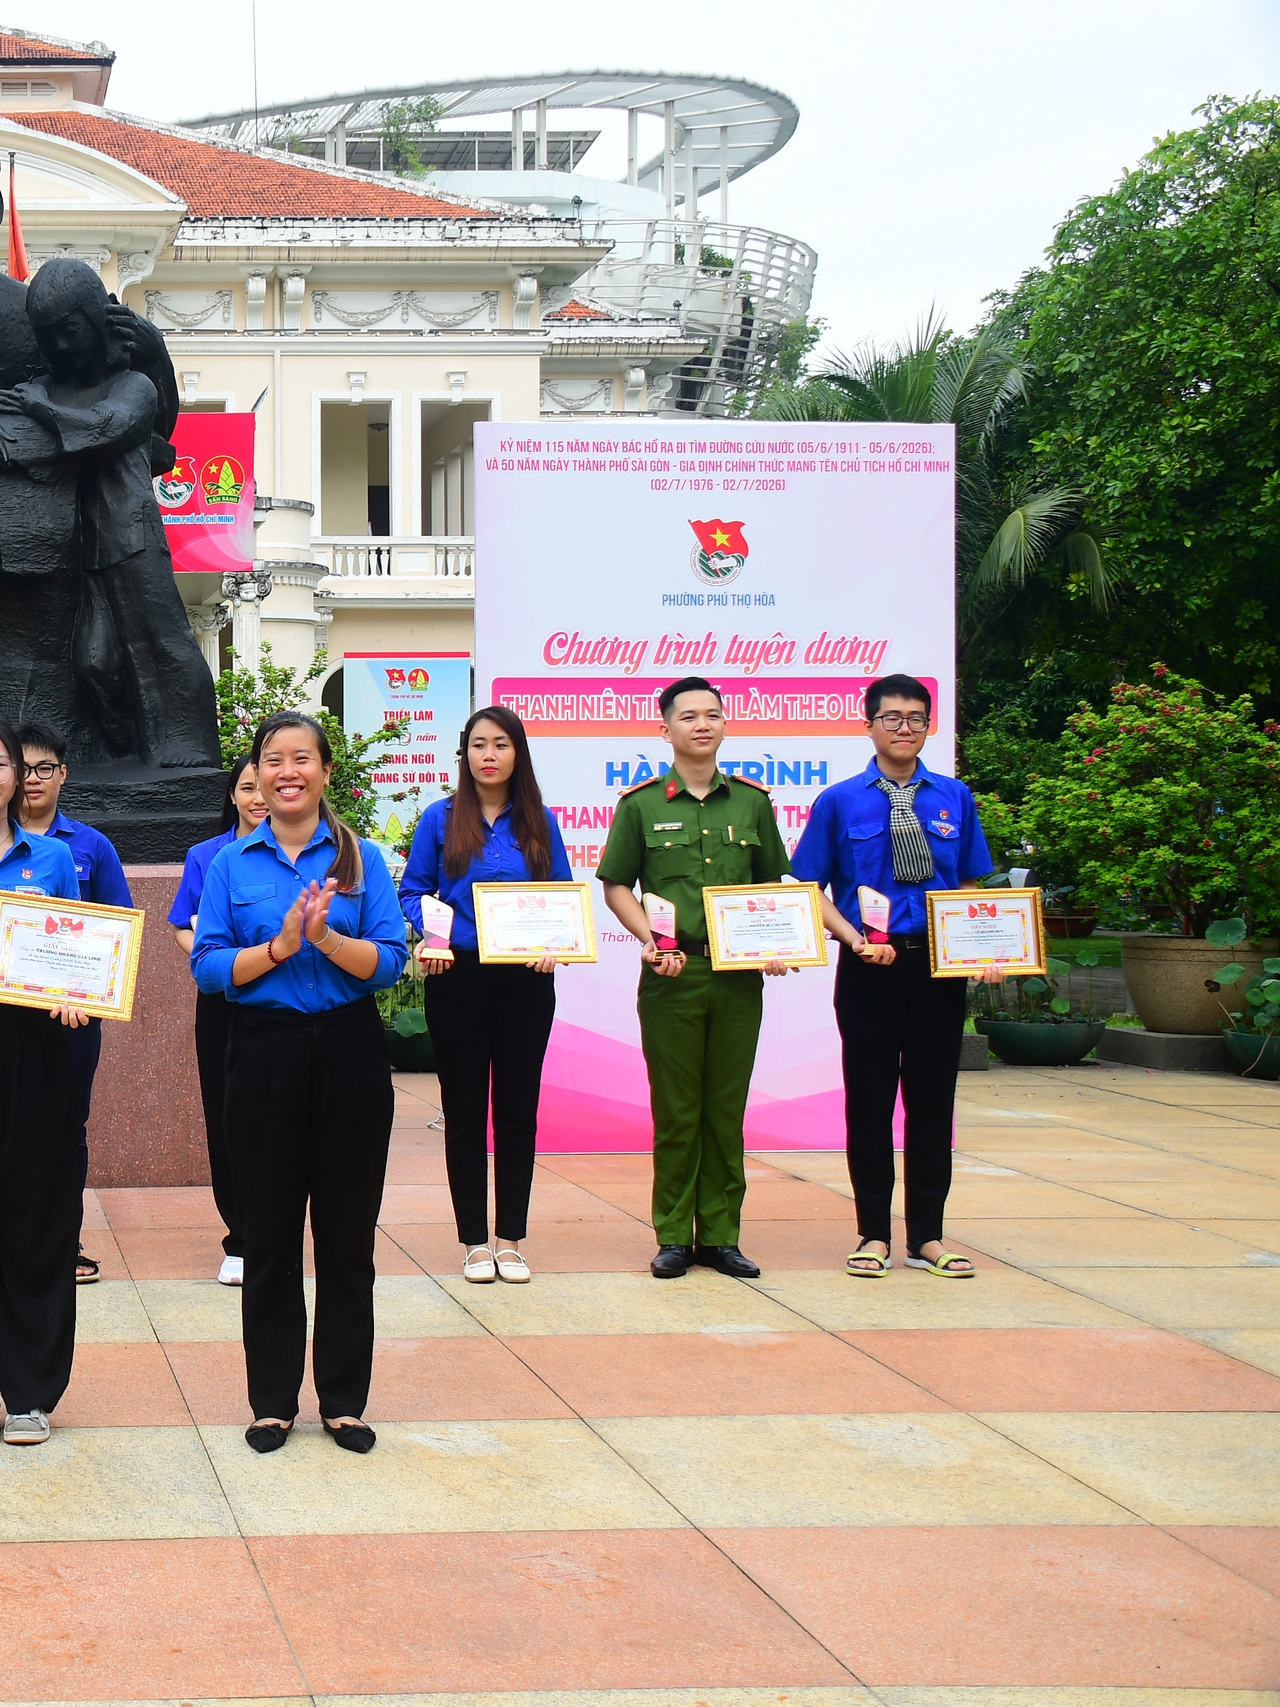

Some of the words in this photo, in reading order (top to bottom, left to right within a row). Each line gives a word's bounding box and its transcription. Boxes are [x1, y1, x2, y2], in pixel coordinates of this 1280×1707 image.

[500, 436, 514, 452] KỶ
[516, 438, 542, 455] NIỆM
[546, 440, 564, 453] 115
[566, 438, 590, 453] NĂM
[592, 440, 620, 453] NGÀY
[622, 440, 642, 453] BÁC
[644, 437, 658, 454] HỒ
[660, 440, 674, 454] RA
[676, 440, 686, 454] ĐI
[688, 440, 707, 454] TÌM
[708, 440, 743, 454] ĐƯỜNG
[745, 440, 765, 454] CỨU
[767, 440, 794, 454] NƯỚC
[797, 440, 859, 454] (05/6/1911
[869, 440, 935, 454] 05/6/2026);
[485, 457, 499, 471] VÀ
[501, 458, 515, 471] 50
[517, 456, 540, 471] NĂM
[542, 458, 570, 472] NGÀY
[572, 458, 606, 472] THÀNH
[609, 456, 629, 472] PHỐ
[631, 459, 648, 472] SÀI
[650, 459, 670, 472] GÒN
[679, 459, 696, 472] GIA
[698, 459, 723, 474] ĐỊNH
[724, 459, 756, 472] CHÍNH
[758, 459, 784, 473] THỨC
[786, 459, 816, 472] MANG
[818, 457, 838, 472] TÊN
[840, 456, 861, 473] CHỦ
[862, 459, 886, 474] TỊCH
[888, 456, 902, 473] HỒ
[904, 459, 921, 473] CHÍ
[923, 460, 950, 472] MINH
[650, 478, 714, 491] (02/7/1976
[722, 478, 786, 491] 02/7/2026)
[662, 590, 704, 606] PHƯỜNG
[707, 590, 728, 606] PHÚ
[730, 593, 751, 609] THỌ
[754, 590, 776, 606] HÒA
[543, 630, 649, 674] Chương
[653, 630, 718, 665] trình
[724, 631, 796, 674] tuyên
[804, 630, 888, 674] dương
[578, 688, 630, 720] NIÊN
[735, 688, 782, 720] LÀM
[784, 694, 843, 720] THEO
[438, 772, 449, 782] TA
[718, 754, 828, 786] TRÌNH
